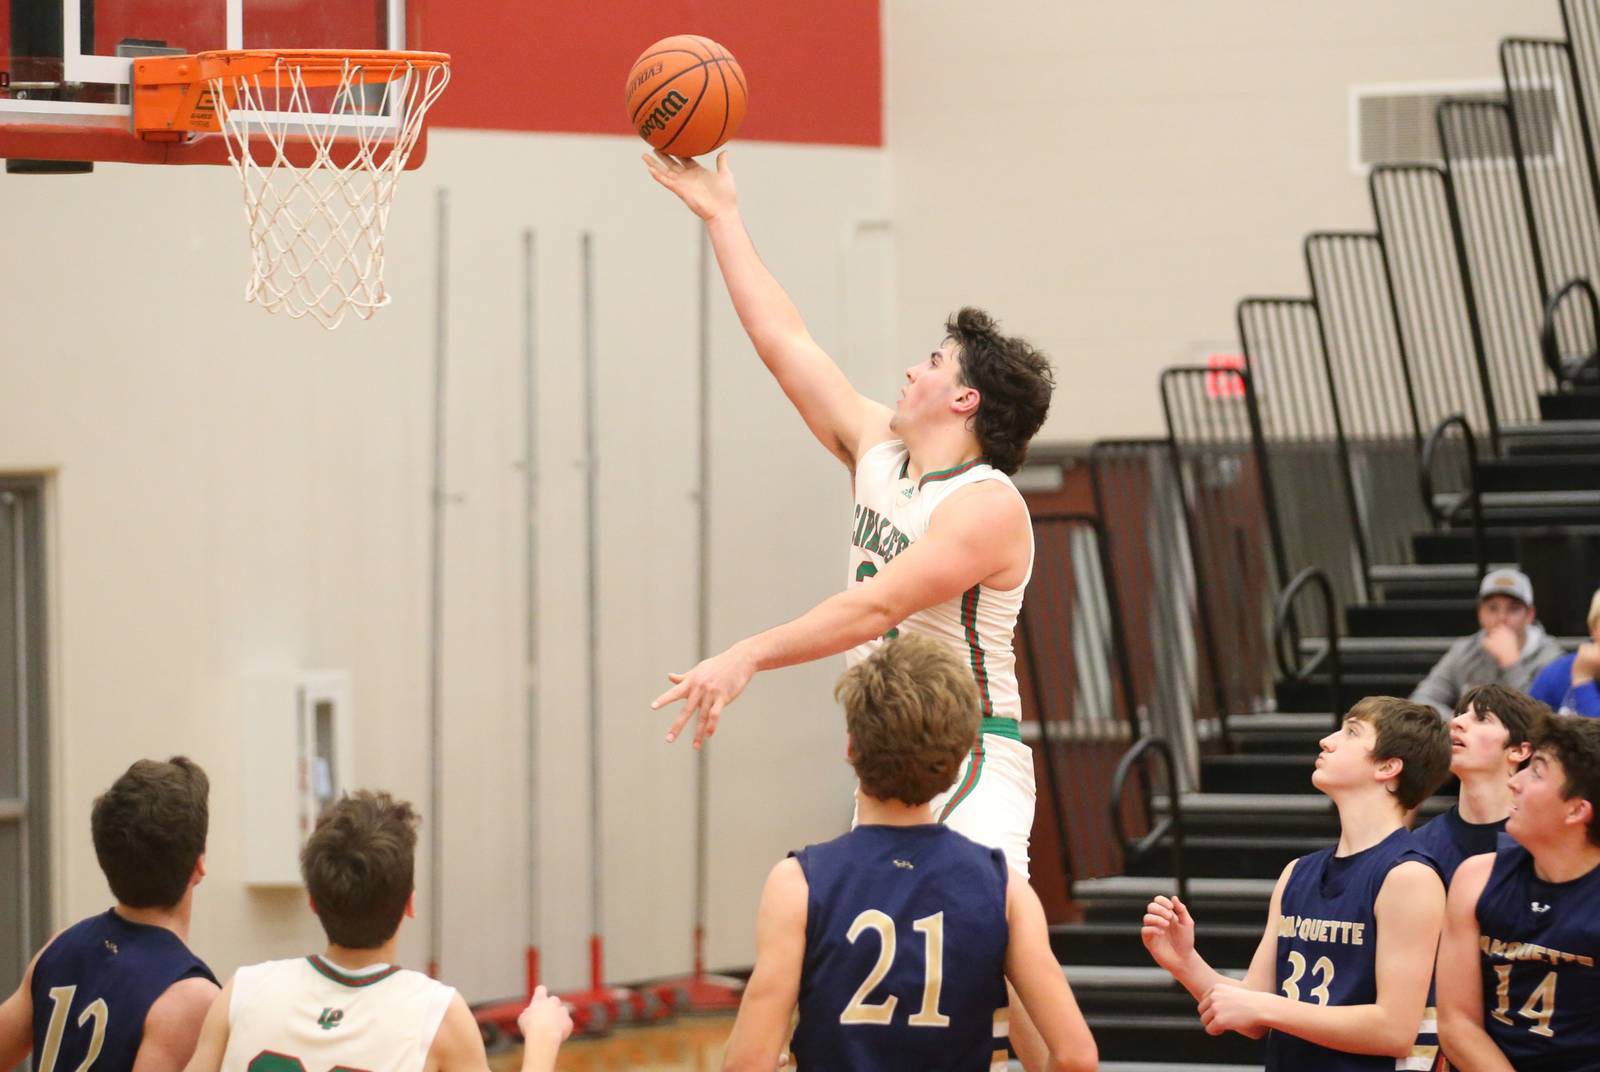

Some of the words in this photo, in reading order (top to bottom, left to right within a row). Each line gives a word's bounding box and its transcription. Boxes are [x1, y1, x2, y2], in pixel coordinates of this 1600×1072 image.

[840, 908, 950, 1027] 21
[1281, 950, 1335, 1006] 33
[1491, 964, 1558, 1038] 14
[38, 984, 109, 1072] 12
